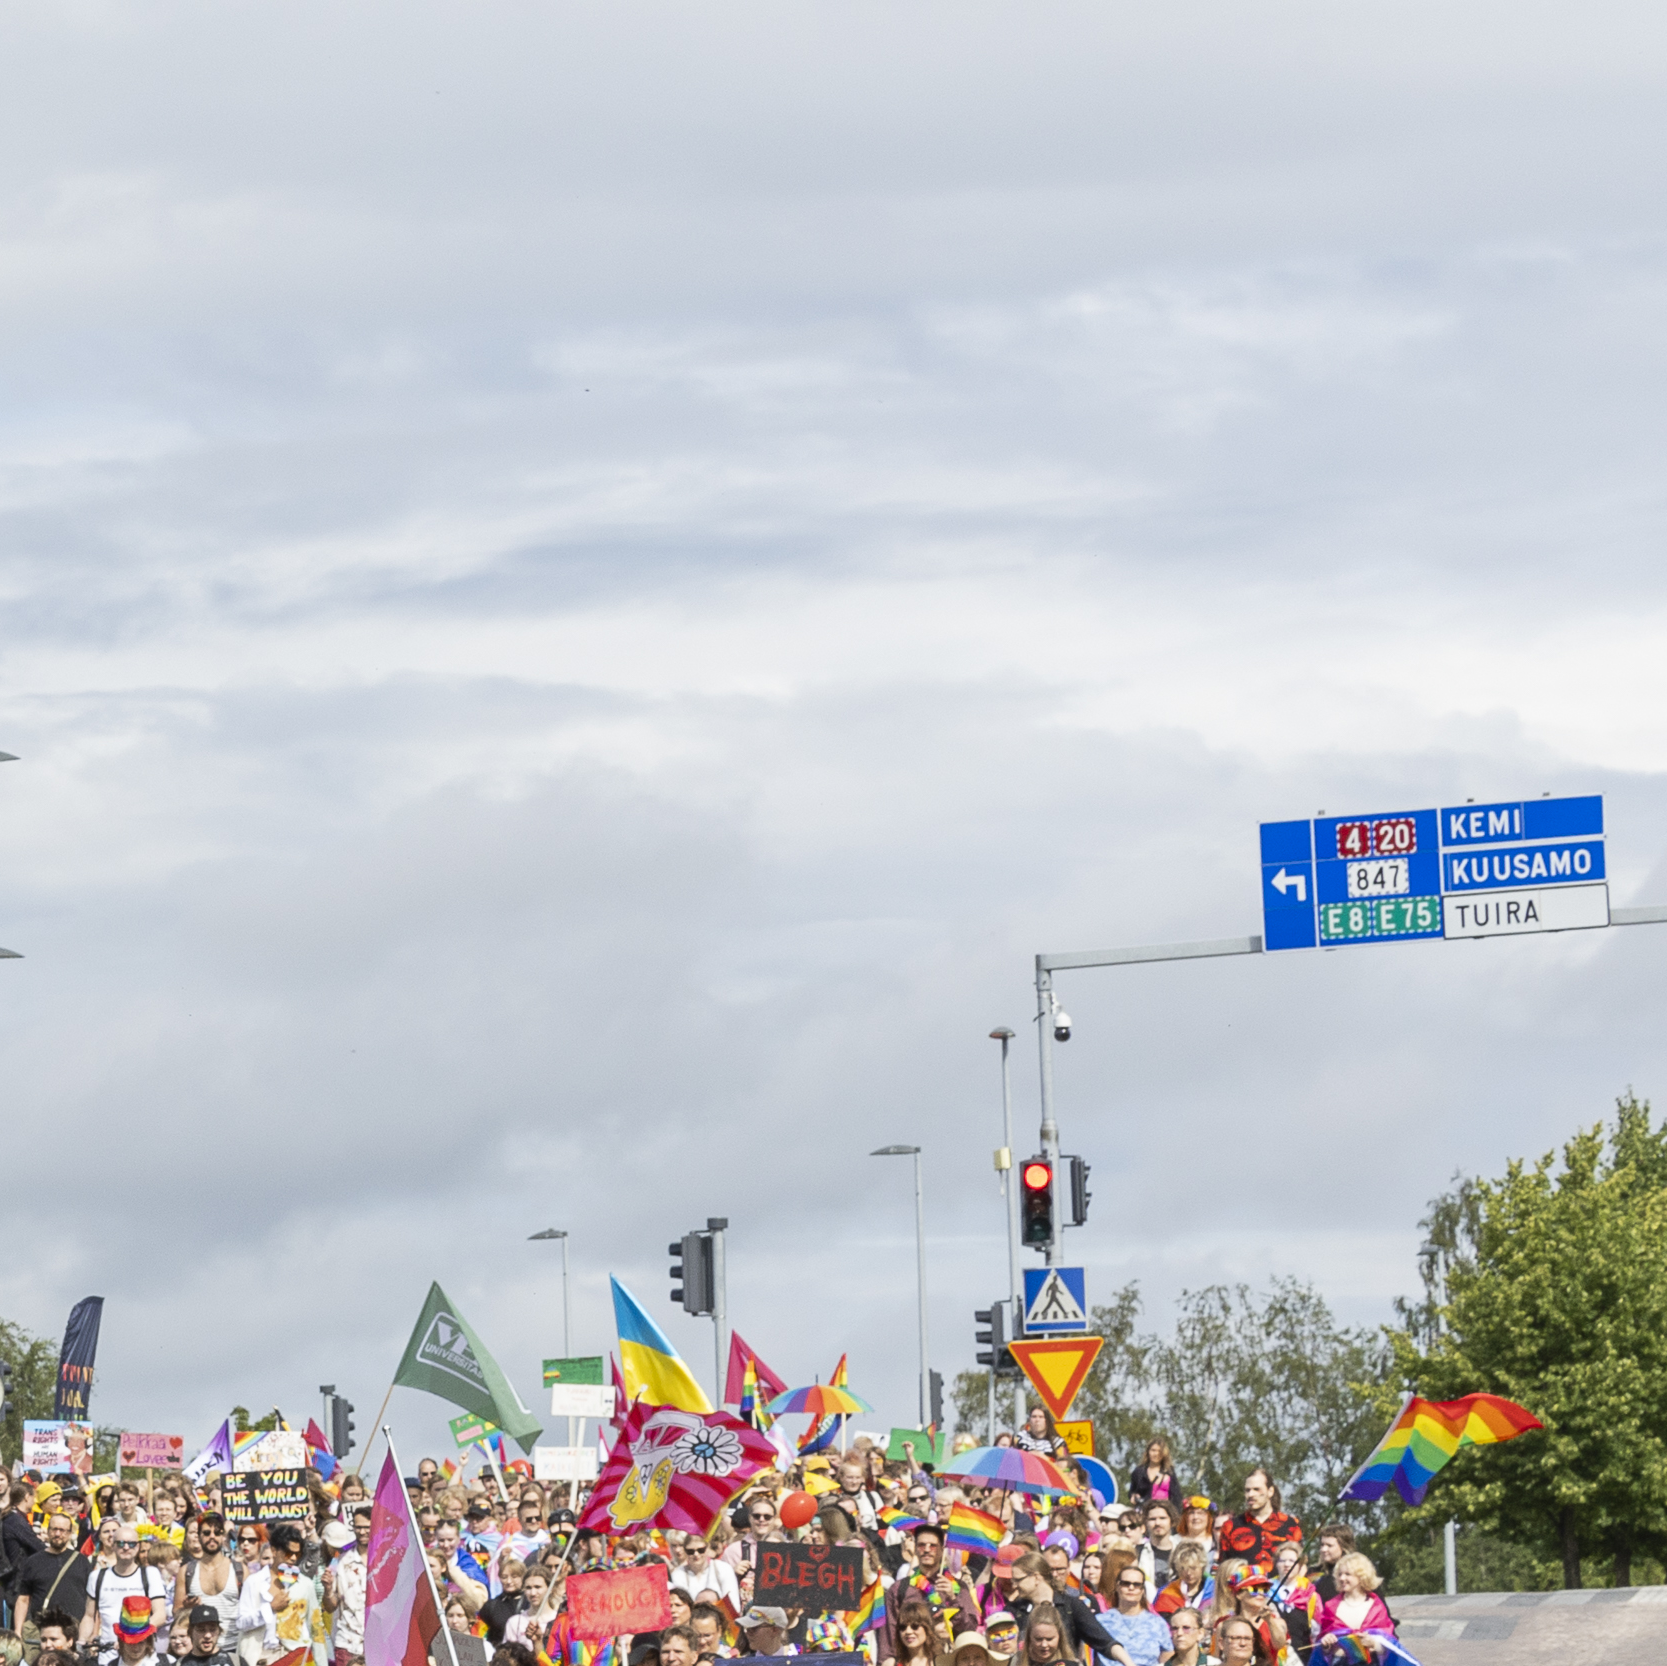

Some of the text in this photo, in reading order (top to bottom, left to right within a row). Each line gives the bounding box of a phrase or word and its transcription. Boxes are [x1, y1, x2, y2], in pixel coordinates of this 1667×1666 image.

[1449, 808, 1521, 840] KEMI
[1345, 824, 1411, 853] 4 20
[1355, 865, 1402, 891] 847
[1452, 848, 1592, 884] KUUSAMO
[1328, 906, 1364, 933] E 8
[1381, 901, 1433, 929] E 75
[1455, 900, 1540, 929] TUIRA
[225, 1470, 298, 1489] BE YOU
[223, 1486, 307, 1506] THE WORLD
[224, 1503, 309, 1521] WILL ADJUST
[760, 1552, 856, 1600] BLEGH
